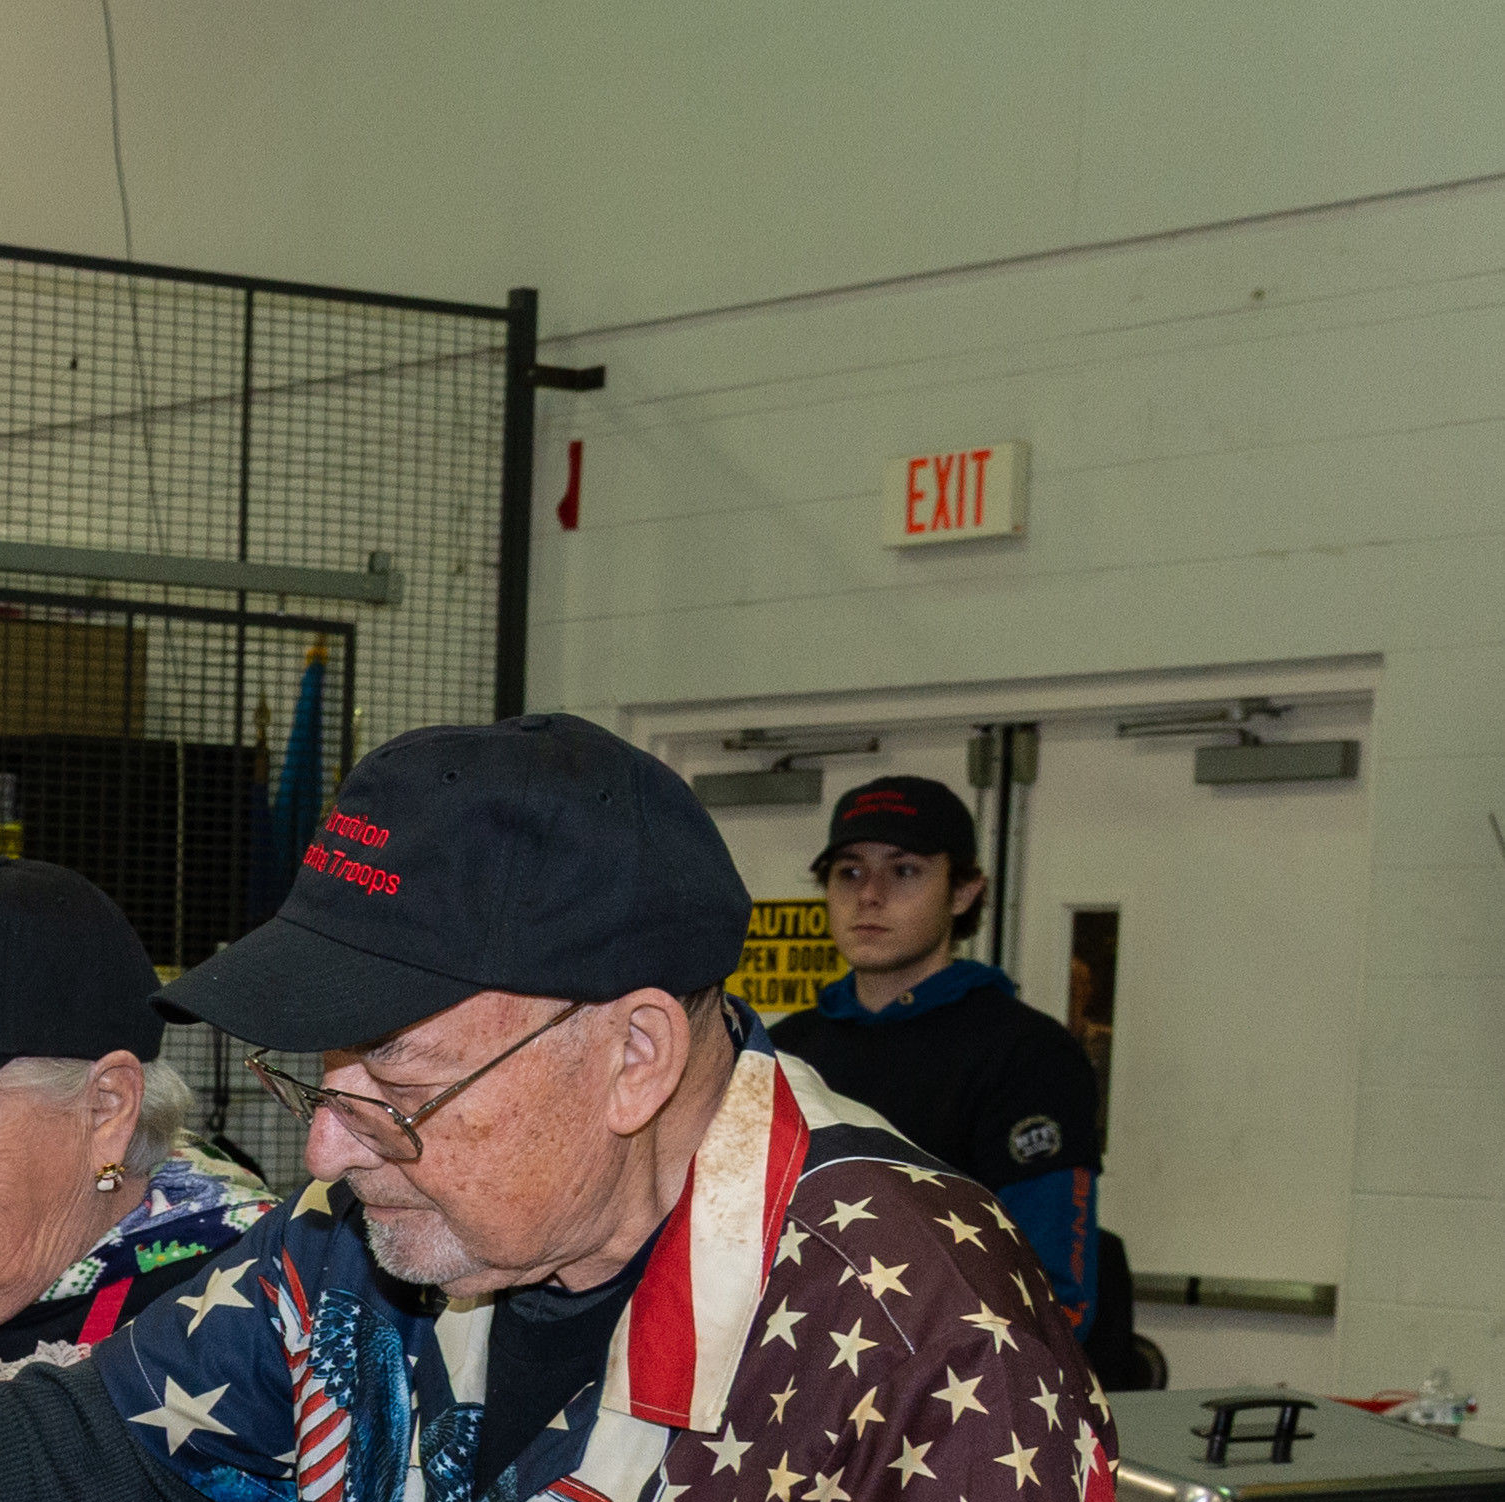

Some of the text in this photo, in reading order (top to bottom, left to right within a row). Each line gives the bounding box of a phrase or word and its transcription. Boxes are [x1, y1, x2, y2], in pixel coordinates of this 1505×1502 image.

[906, 449, 992, 535] EXIT
[328, 849, 400, 895] Troops
[748, 906, 827, 936] AUTIO
[738, 945, 838, 973] PEN DOOR
